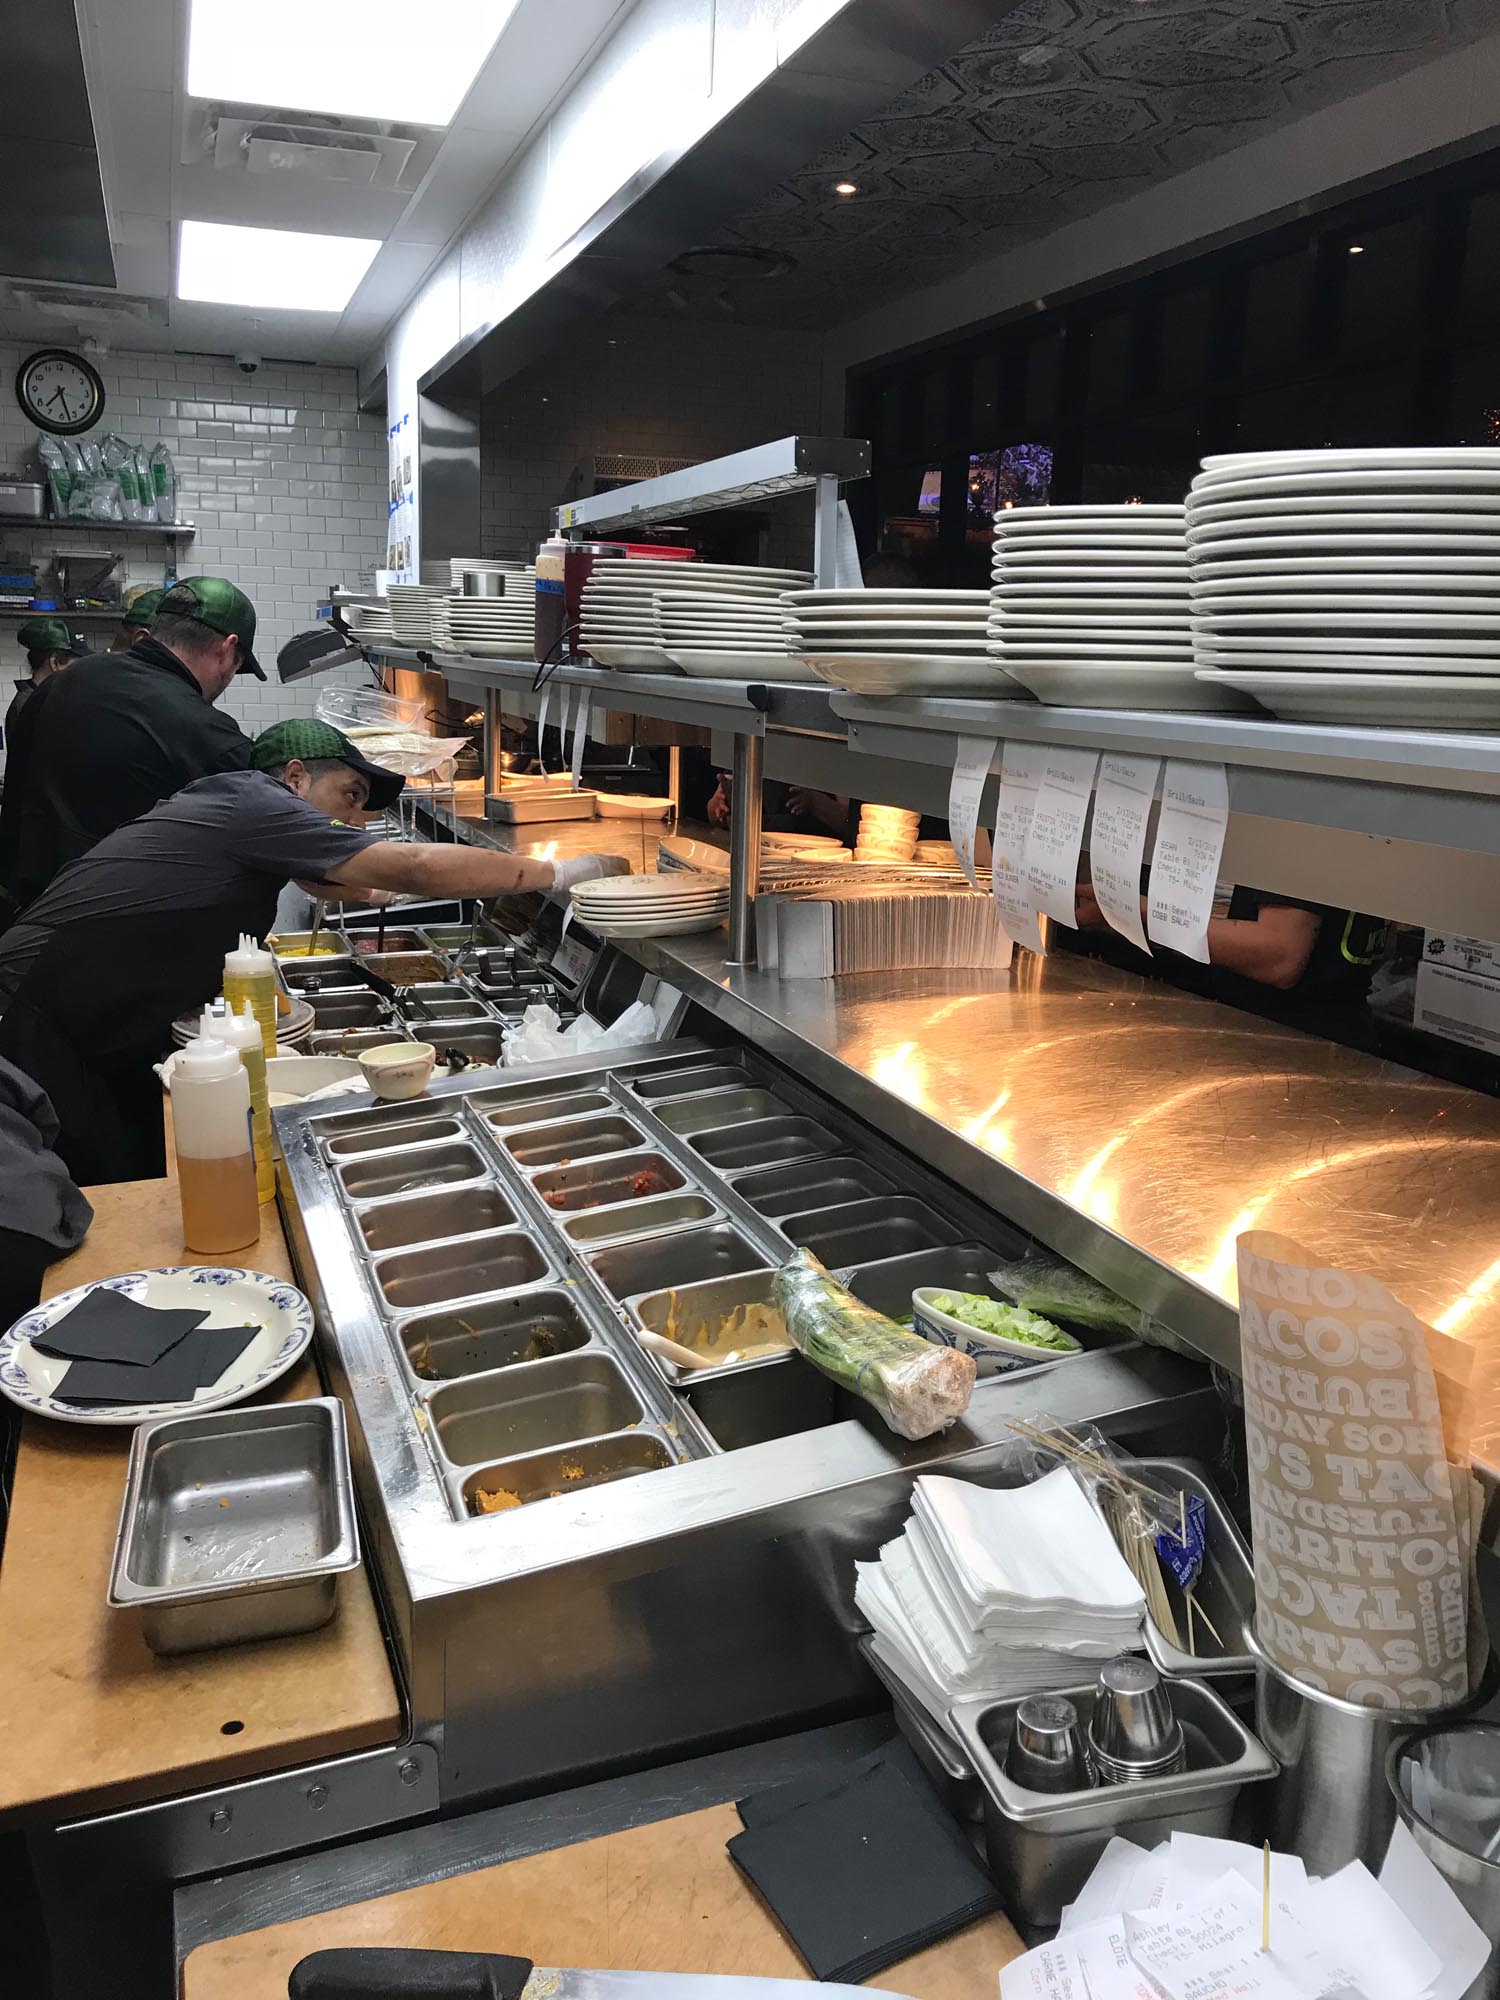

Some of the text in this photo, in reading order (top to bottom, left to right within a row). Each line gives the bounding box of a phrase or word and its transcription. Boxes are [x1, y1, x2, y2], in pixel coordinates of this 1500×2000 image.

[1261, 1479, 1448, 1537] TUESDAY
[1132, 1922, 1170, 1943] Ashley
[1139, 1936, 1173, 1954] Table
[1040, 1951, 1057, 1984] CARNE
[1109, 1933, 1129, 1969] ELOTE
